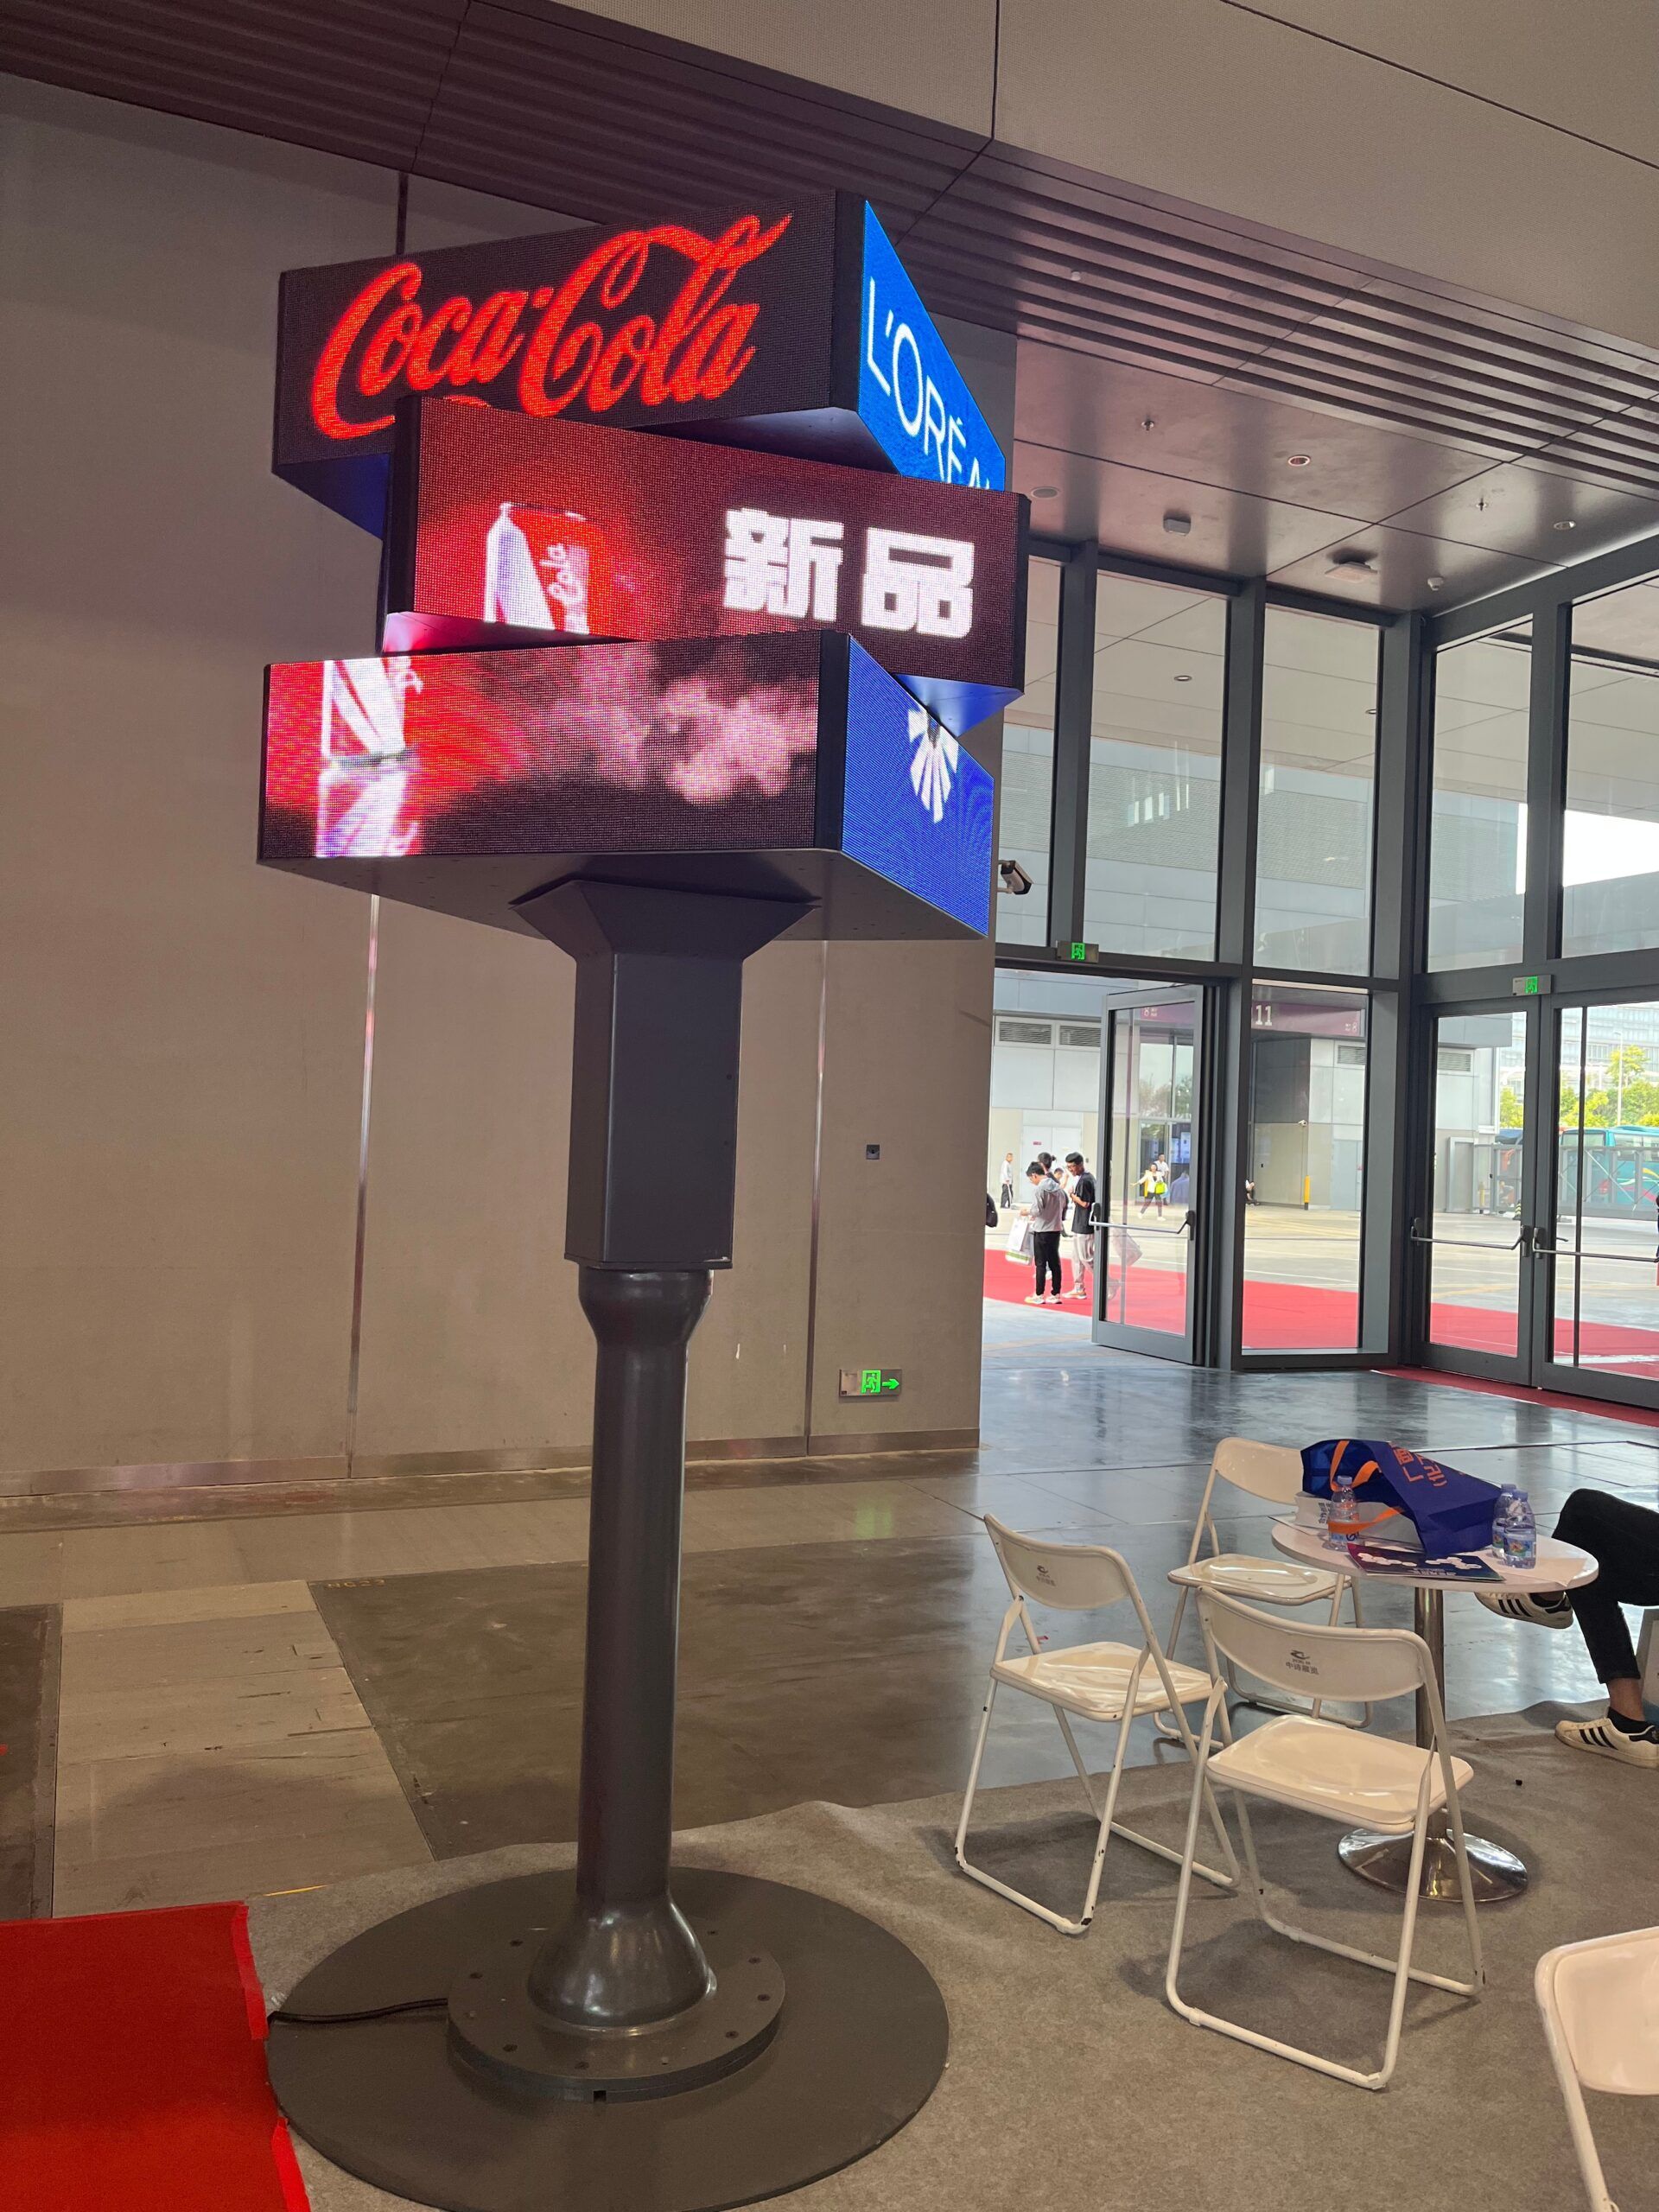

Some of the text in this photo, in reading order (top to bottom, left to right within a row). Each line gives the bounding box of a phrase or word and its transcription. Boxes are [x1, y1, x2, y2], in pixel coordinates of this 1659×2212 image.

[868, 276, 990, 490] L'ORÉ
[723, 507, 975, 638] 新品
[1255, 1005, 1273, 1026] 11
